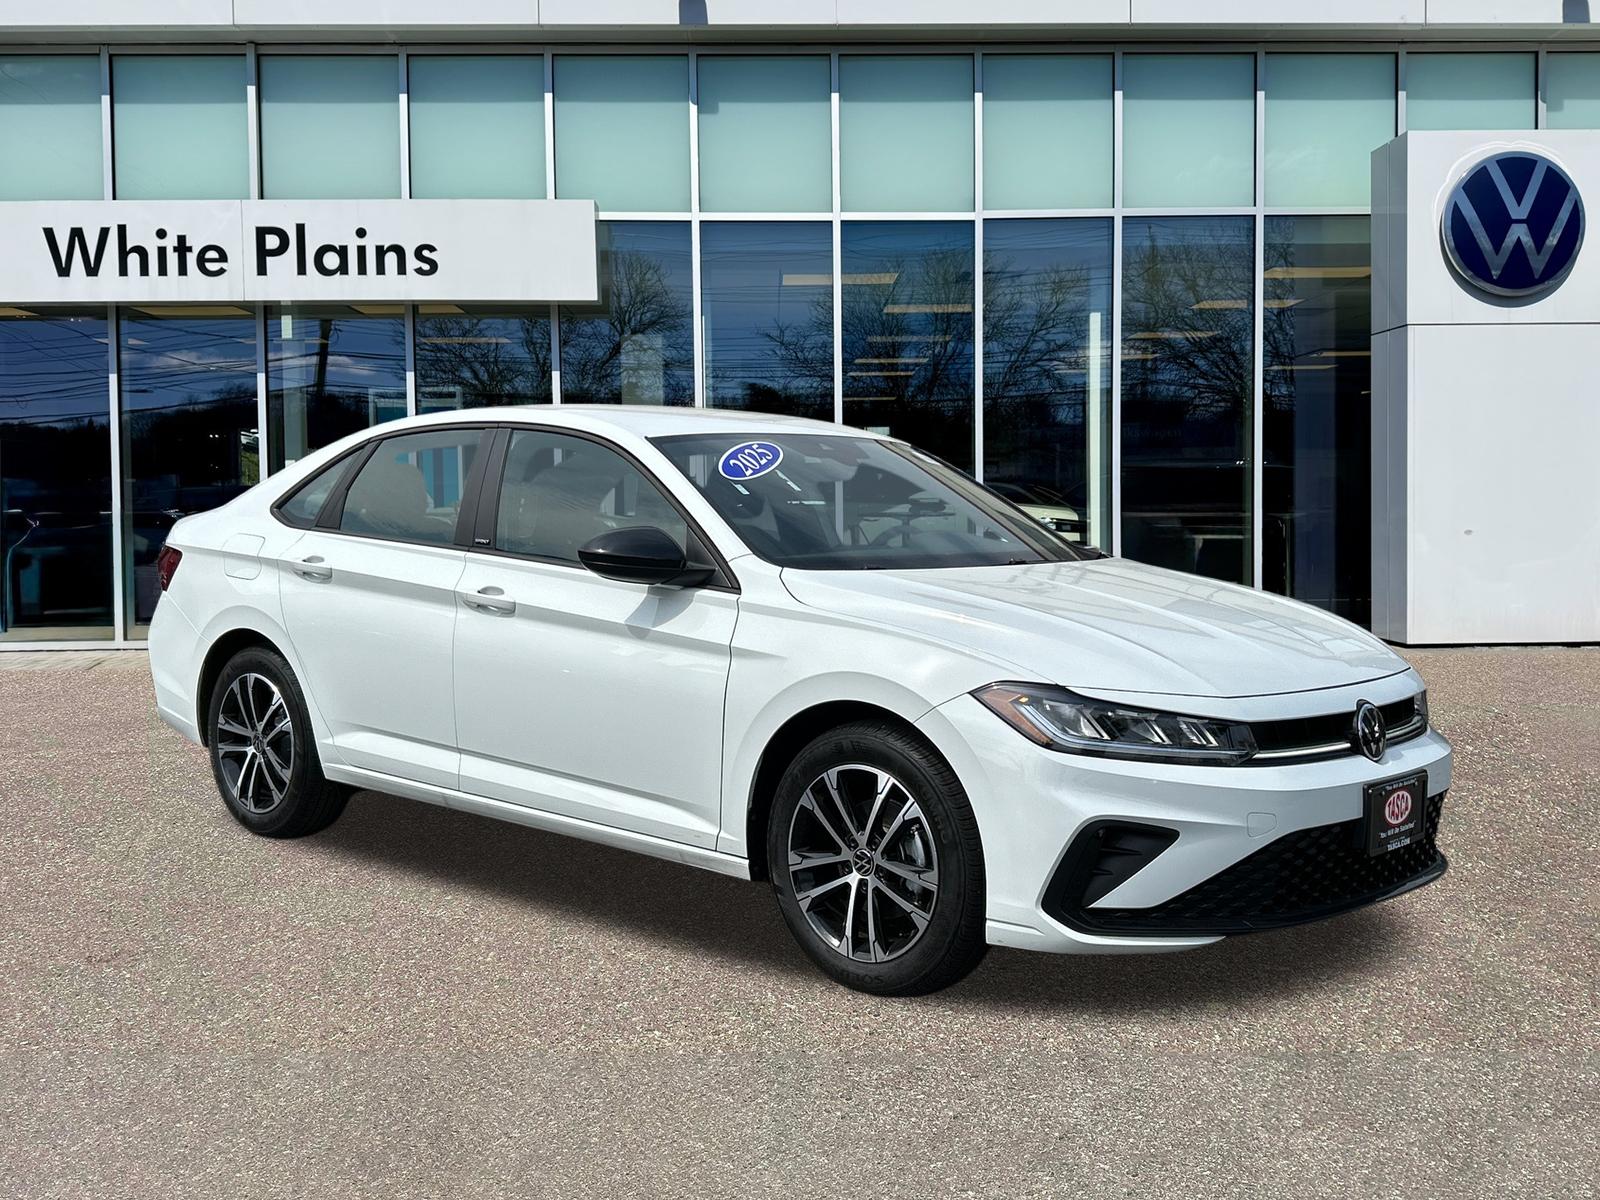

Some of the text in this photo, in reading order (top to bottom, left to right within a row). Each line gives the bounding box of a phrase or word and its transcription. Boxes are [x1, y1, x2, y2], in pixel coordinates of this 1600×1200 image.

[42, 222, 439, 278] White Plains
[729, 443, 774, 477] 2025
[1387, 793, 1410, 821] TASCA
